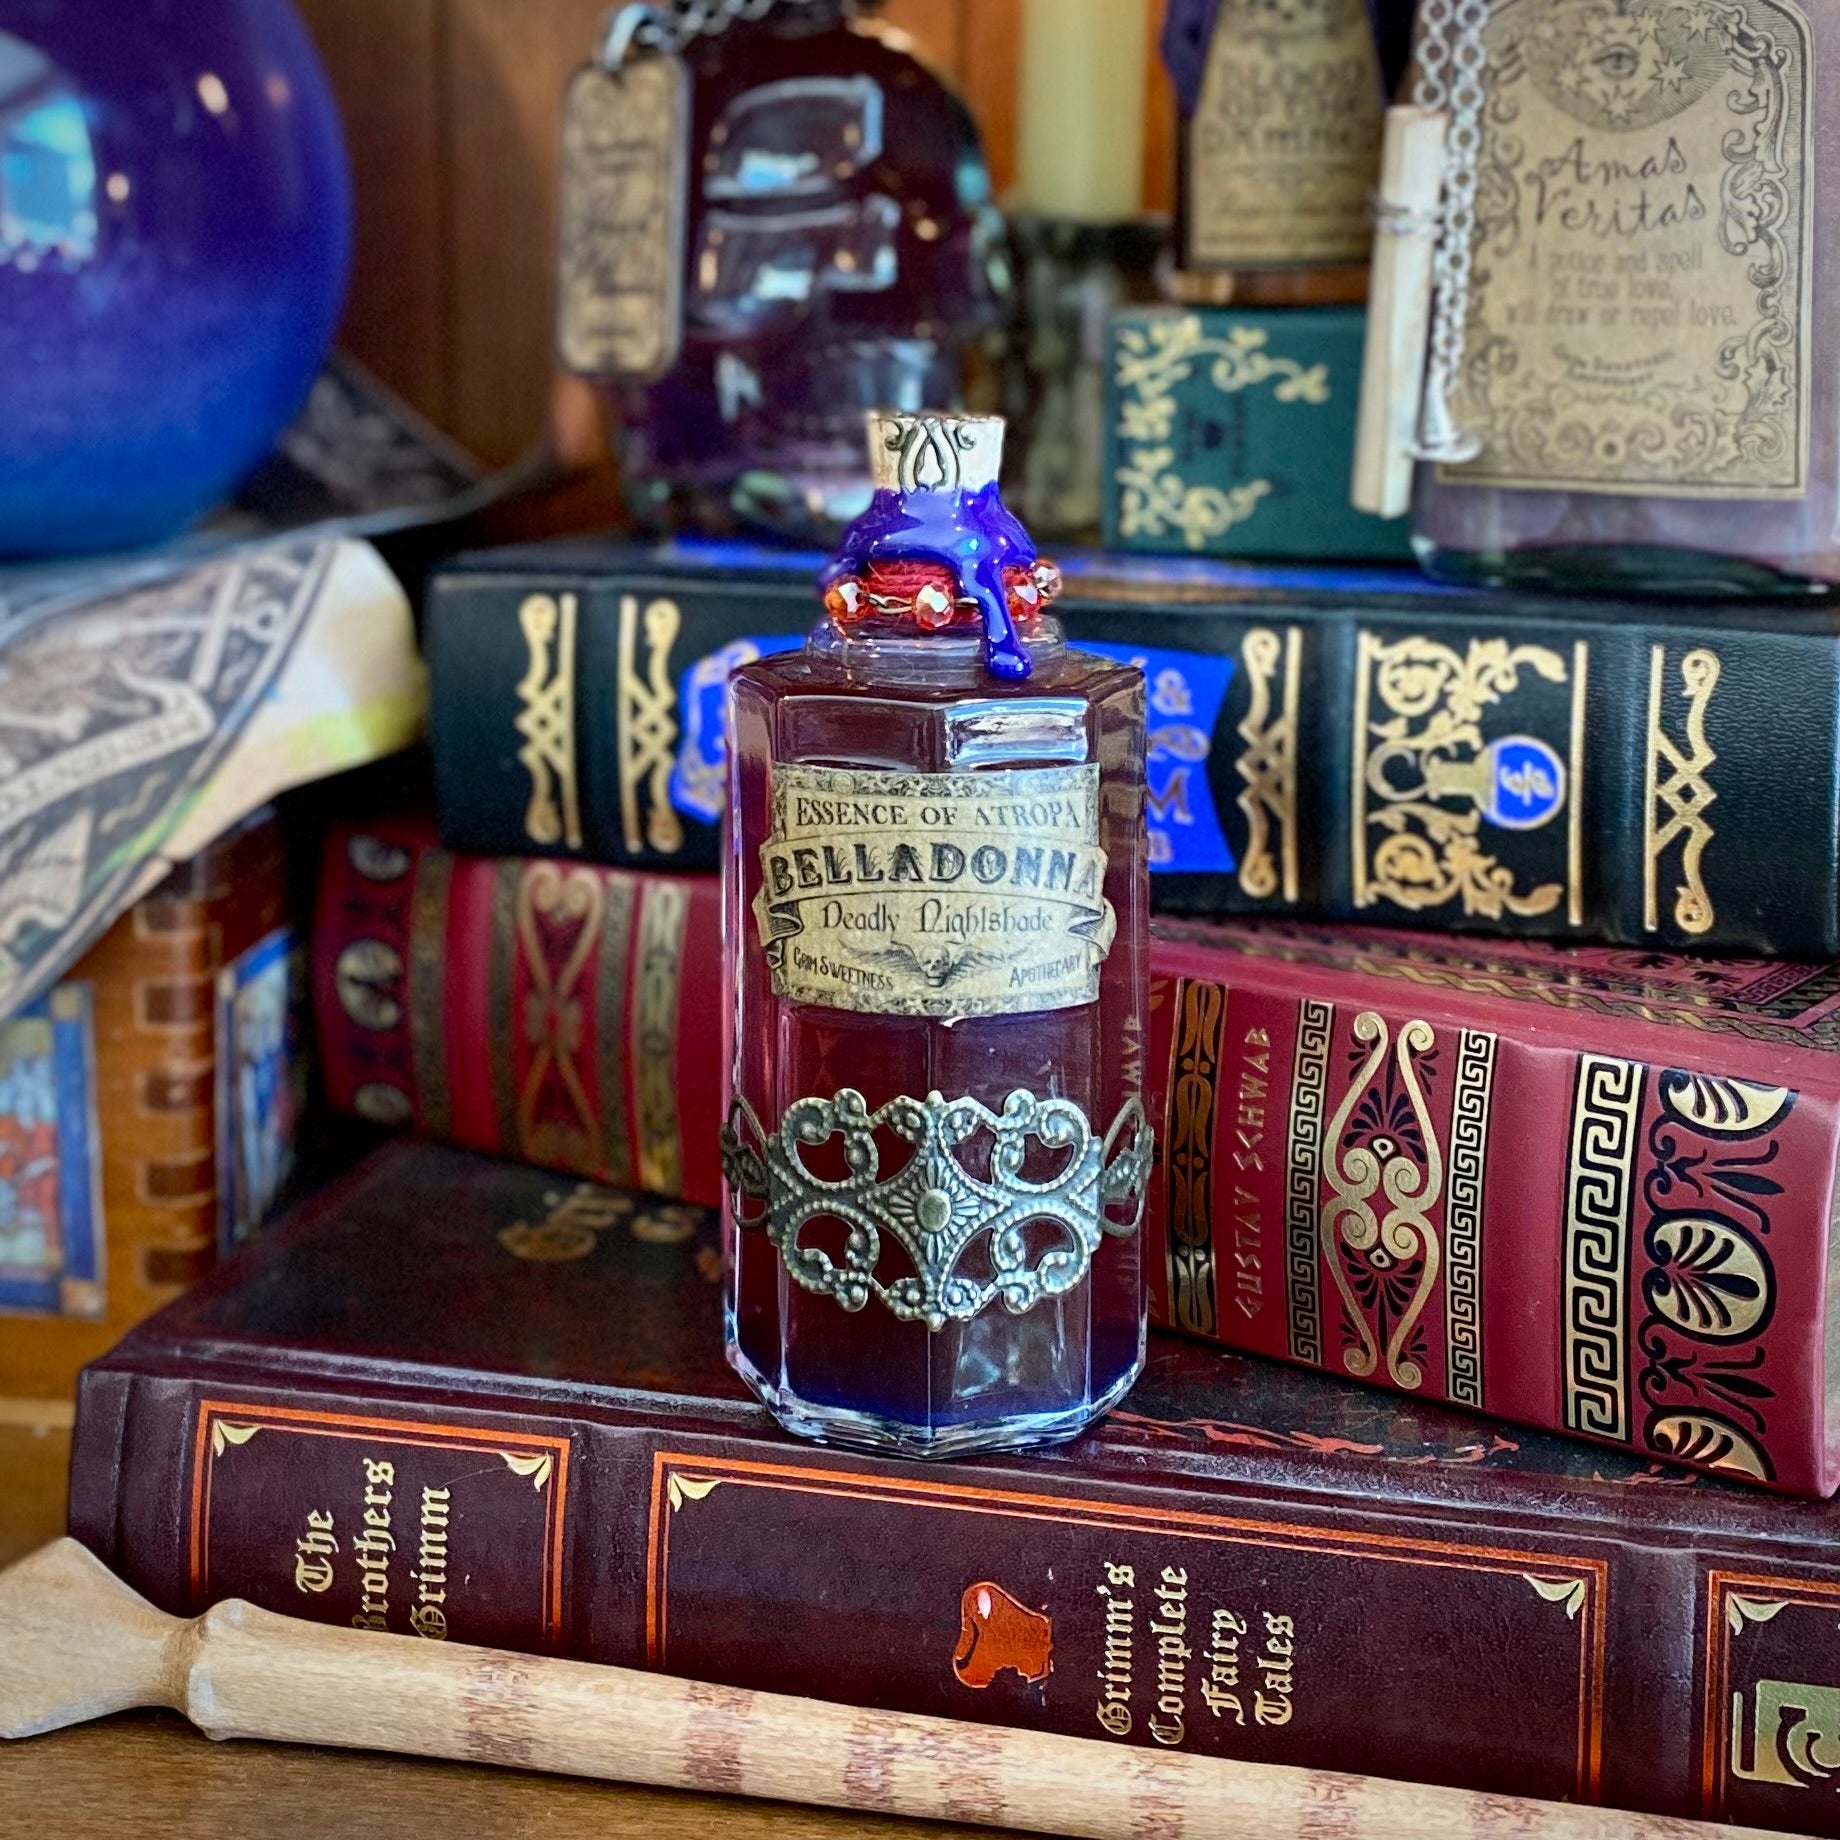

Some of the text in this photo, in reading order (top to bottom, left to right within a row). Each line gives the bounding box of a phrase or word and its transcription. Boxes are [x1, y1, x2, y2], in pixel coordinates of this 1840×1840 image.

[1539, 137, 1688, 186] Amas
[1525, 171, 1707, 240] Veritas
[1656, 244, 1703, 279] spell
[795, 798, 1082, 829] ESSENCE OF ATROPA
[769, 841, 1098, 900] BELLADONNA
[821, 897, 1054, 941] Deadly Nightshade
[1232, 1026, 1271, 1319] GUSTAV SCHWAB
[295, 1508, 340, 1594] The
[410, 1485, 452, 1640] Grimm
[1096, 1561, 1137, 1736] Grimm's
[1148, 1565, 1193, 1745] Complete
[1201, 1607, 1248, 1727] Fairy
[1253, 1610, 1295, 1726] Tales
